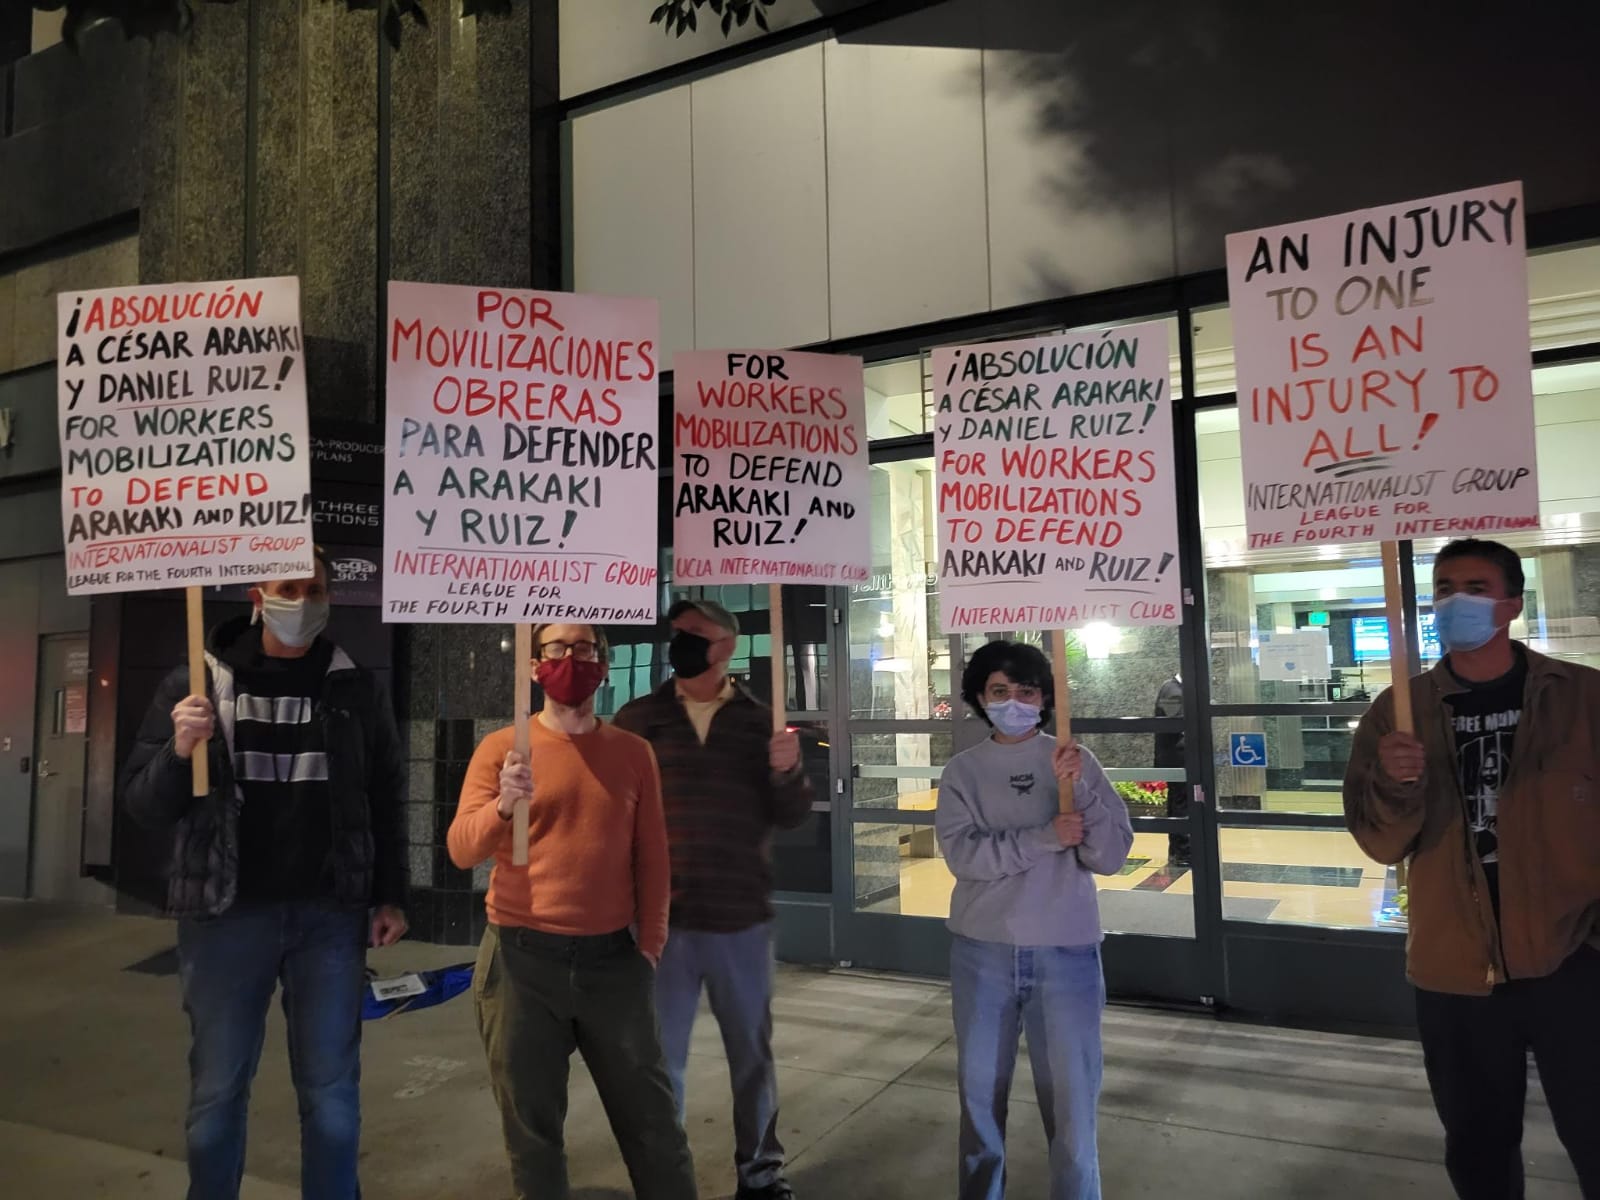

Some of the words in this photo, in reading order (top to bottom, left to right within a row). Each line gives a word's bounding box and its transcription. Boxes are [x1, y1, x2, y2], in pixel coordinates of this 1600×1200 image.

[1245, 233, 1309, 283] AN
[1344, 197, 1518, 267] INJURY
[66, 286, 263, 337] ¡ABSOLUCIÓN
[478, 291, 564, 331] POR
[1266, 286, 1318, 321] TO
[1335, 266, 1436, 316] ONE
[66, 344, 84, 367] A
[97, 330, 193, 364] CÉSAR
[203, 325, 300, 356] ARAKAKI
[392, 318, 656, 382] MOVILIZACIONES
[946, 330, 1138, 386] ¡ABSOLUCIÓN
[1290, 333, 1329, 373] IS
[1352, 316, 1423, 364] AN
[66, 379, 84, 410] Y
[99, 370, 193, 403] DANIEL
[207, 356, 294, 396] RUIZ!
[728, 354, 789, 380] FOR
[434, 376, 622, 426] OBRERAS
[698, 380, 847, 420] WORKERS
[938, 394, 952, 413] A
[958, 382, 1042, 413] CÉSAR
[1052, 378, 1164, 409] ARAKAKI
[1252, 368, 1428, 425] INJURY
[1449, 365, 1499, 410] TO
[65, 415, 118, 440] FOR
[134, 404, 273, 437] WORKERS
[675, 412, 858, 456] MOBILIZATIONS
[958, 416, 1057, 442] DANIEL
[1070, 404, 1156, 440] RUIZ!
[1303, 413, 1440, 467] ALL!
[68, 433, 296, 478] MOBILIZATIONS
[400, 418, 485, 458] PARA
[503, 422, 656, 470] DEFENDER
[681, 454, 709, 477] TO
[730, 453, 842, 487] DEFEND
[941, 450, 986, 476] FOR
[1002, 444, 1156, 483] WORKERS
[71, 486, 103, 508] TO
[127, 473, 269, 506] DEFEND
[393, 470, 414, 496] A
[437, 467, 601, 508] ARAKAKI
[676, 482, 789, 518] ARAKAKI
[809, 496, 856, 519] AND
[940, 481, 1142, 517] MOBILIZATIONS
[1250, 470, 1446, 511] INTERNATIONALIST
[1452, 467, 1530, 494] GROUP
[68, 506, 183, 544] ARAKAKI
[193, 509, 233, 526] AND
[240, 494, 312, 527] RUIZ!
[313, 512, 379, 526] CTIONS
[318, 500, 379, 515] THREE
[1300, 504, 1380, 526] LEAGUE
[1394, 502, 1432, 514] FOR
[416, 509, 437, 536] Y
[461, 508, 578, 549] RUIZ!
[714, 518, 808, 548] RUIZ!
[946, 518, 982, 544] TO
[995, 518, 1122, 547] DEFEND
[1250, 530, 1284, 548] THE
[1293, 525, 1375, 544] FOURTH
[1395, 515, 1540, 536] INTERNATIONAL
[69, 537, 241, 569] INTERNATIONALIST
[250, 536, 305, 552] GROUP
[394, 550, 598, 584] INTERNATIONALIST
[605, 561, 656, 587] GROUP
[676, 558, 712, 578] UCLA
[720, 558, 836, 578] INTERNATIONALIST
[941, 549, 1046, 578] ARAKAKI
[1055, 556, 1084, 571] AND
[1089, 552, 1174, 584] RUIZ!
[68, 573, 110, 589] LEAGUE
[116, 571, 134, 583] FOR
[139, 569, 161, 581] THE
[167, 566, 212, 579] FOURTH
[219, 561, 313, 577] INTERNATIONAL
[448, 582, 516, 598] LEAGUE
[528, 586, 561, 599] FOR
[390, 600, 418, 613] THE
[426, 600, 508, 617] FOURTH
[523, 602, 654, 620] INTERNATIONAL
[951, 603, 1121, 627] INTERNATIONALIST
[1130, 600, 1176, 620] CLUB
